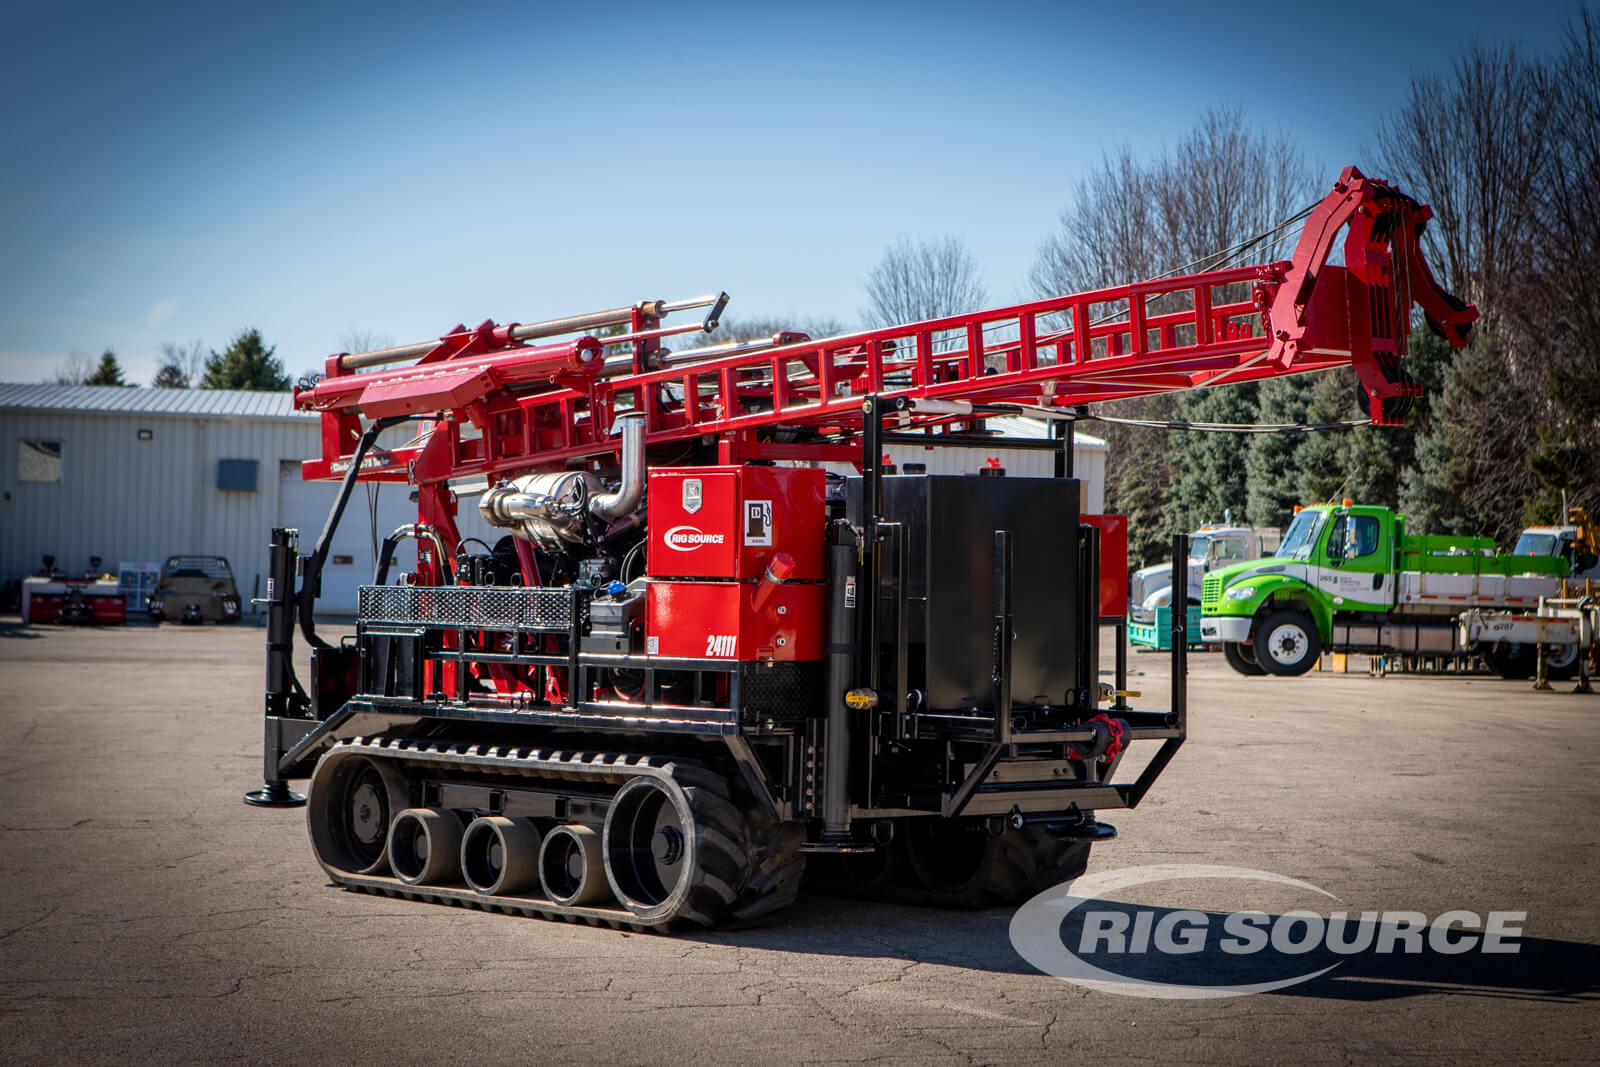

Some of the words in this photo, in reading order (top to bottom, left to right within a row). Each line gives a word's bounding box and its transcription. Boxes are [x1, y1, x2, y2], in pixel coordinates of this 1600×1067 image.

[672, 534, 688, 543] RIG
[688, 534, 725, 544] SOURCE
[705, 634, 737, 657] 24111
